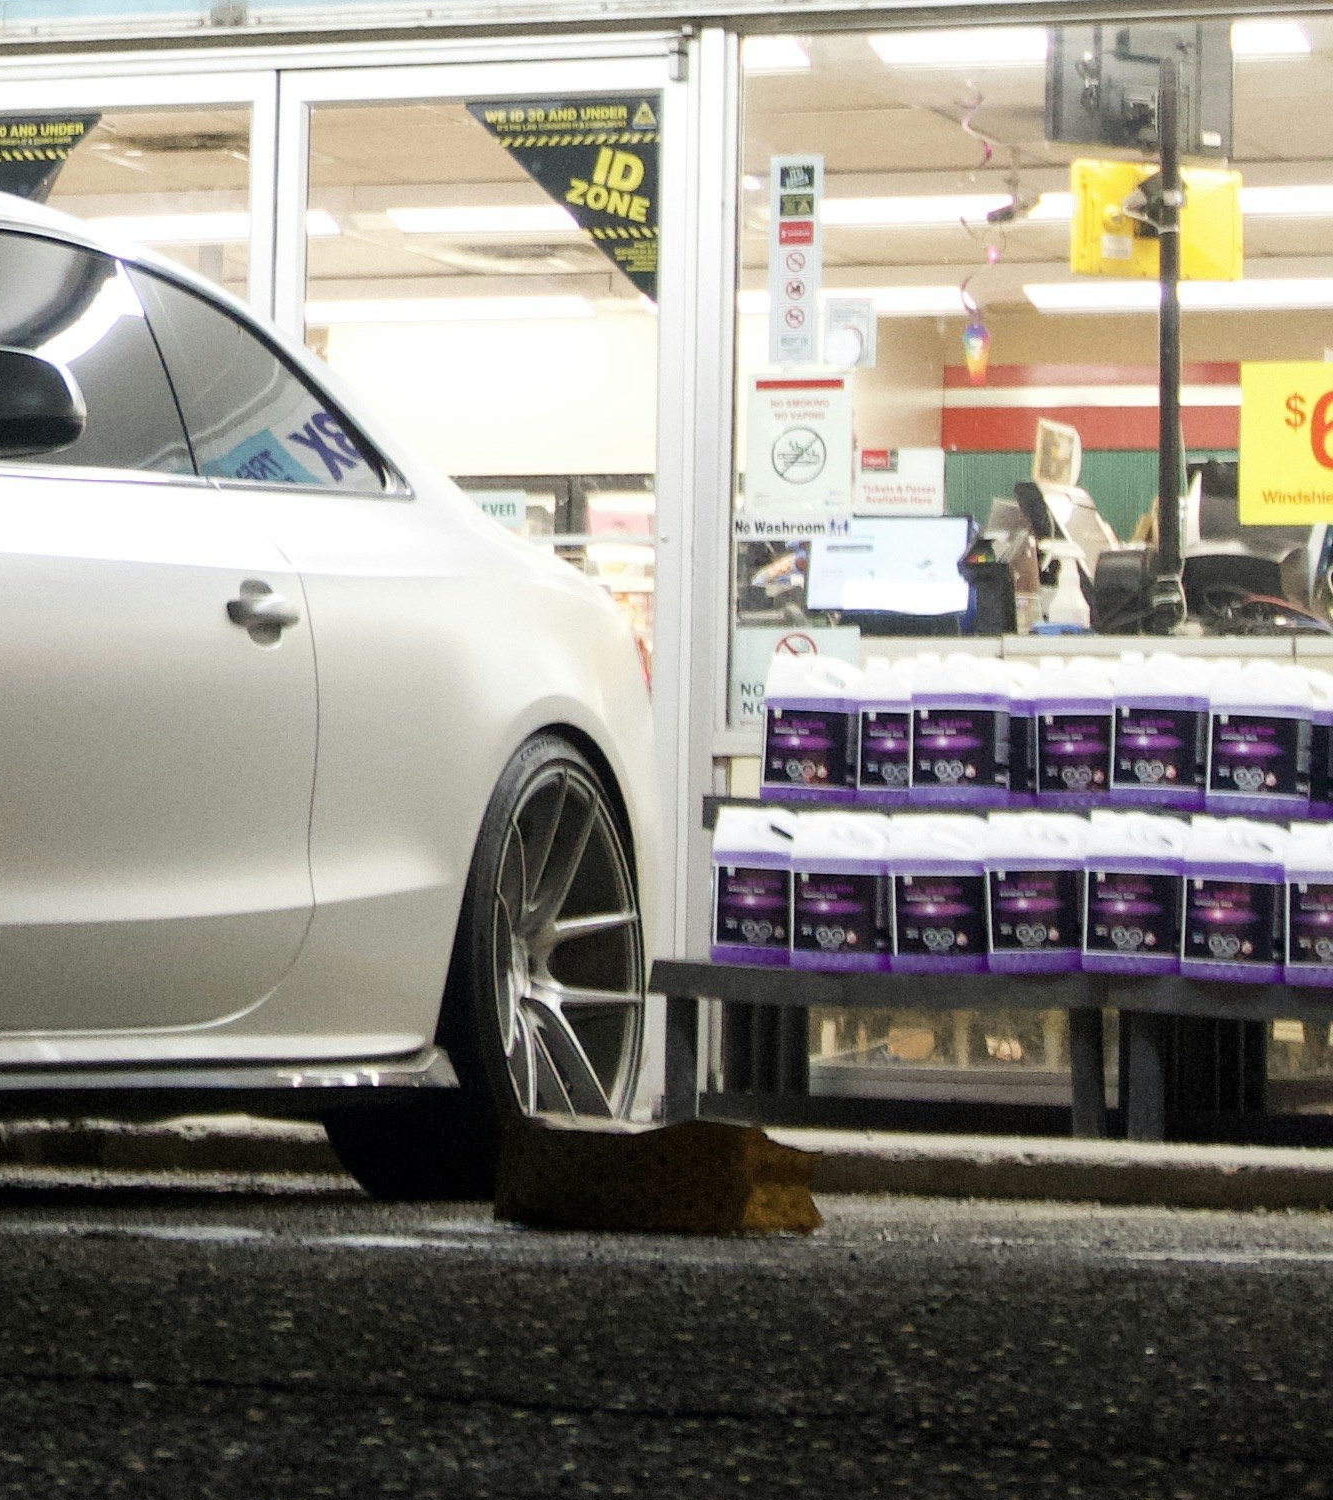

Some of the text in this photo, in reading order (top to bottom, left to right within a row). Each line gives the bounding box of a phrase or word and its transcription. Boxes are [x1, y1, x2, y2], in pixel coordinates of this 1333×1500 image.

[485, 105, 628, 124] WE ID 30 AND UNDER
[10, 123, 38, 138] AND
[40, 121, 85, 136] UNDER
[592, 146, 645, 193] ID
[565, 177, 651, 224] ZONE
[735, 518, 826, 535] No Washroom
[740, 683, 765, 698] NO
